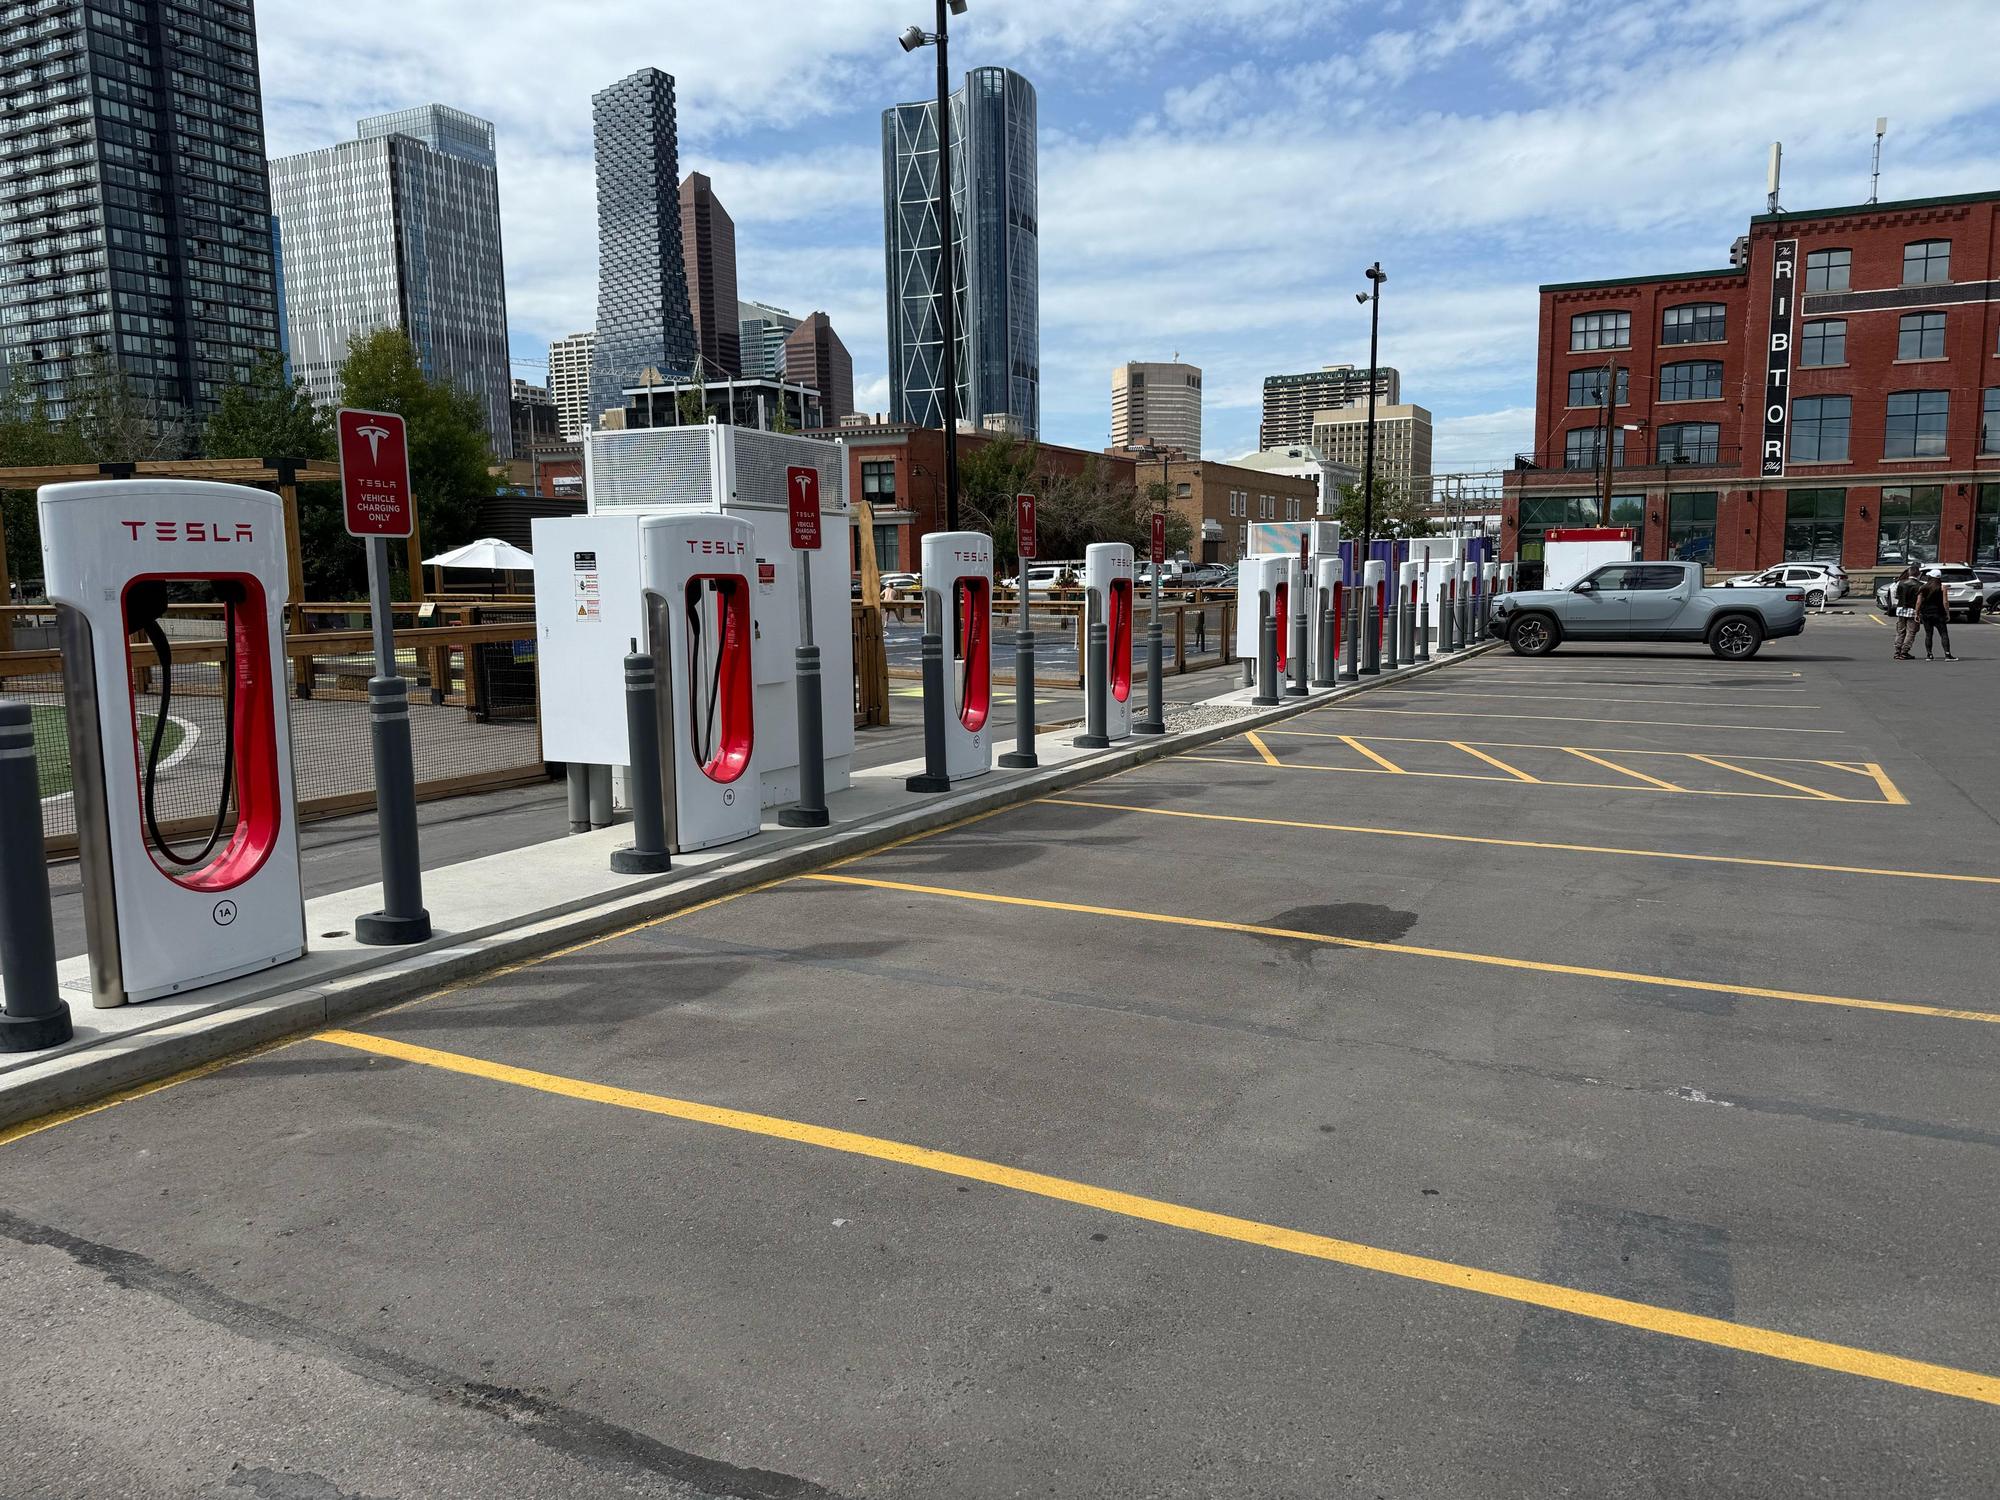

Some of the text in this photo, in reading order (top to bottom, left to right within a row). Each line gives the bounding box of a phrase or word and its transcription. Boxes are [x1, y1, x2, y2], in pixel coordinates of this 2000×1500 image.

[1778, 246, 1792, 257] The
[1764, 260, 1793, 458] RIBTOR
[1764, 461, 1781, 473] Bldg
[357, 479, 397, 489] TESLA
[360, 494, 396, 503] VEHICLE
[356, 503, 401, 513] CHARGING
[368, 513, 391, 521] ONLY
[121, 521, 253, 543] TESLA
[686, 540, 745, 555] TESLA
[954, 551, 989, 562] TESLA
[218, 907, 232, 918] 1A
